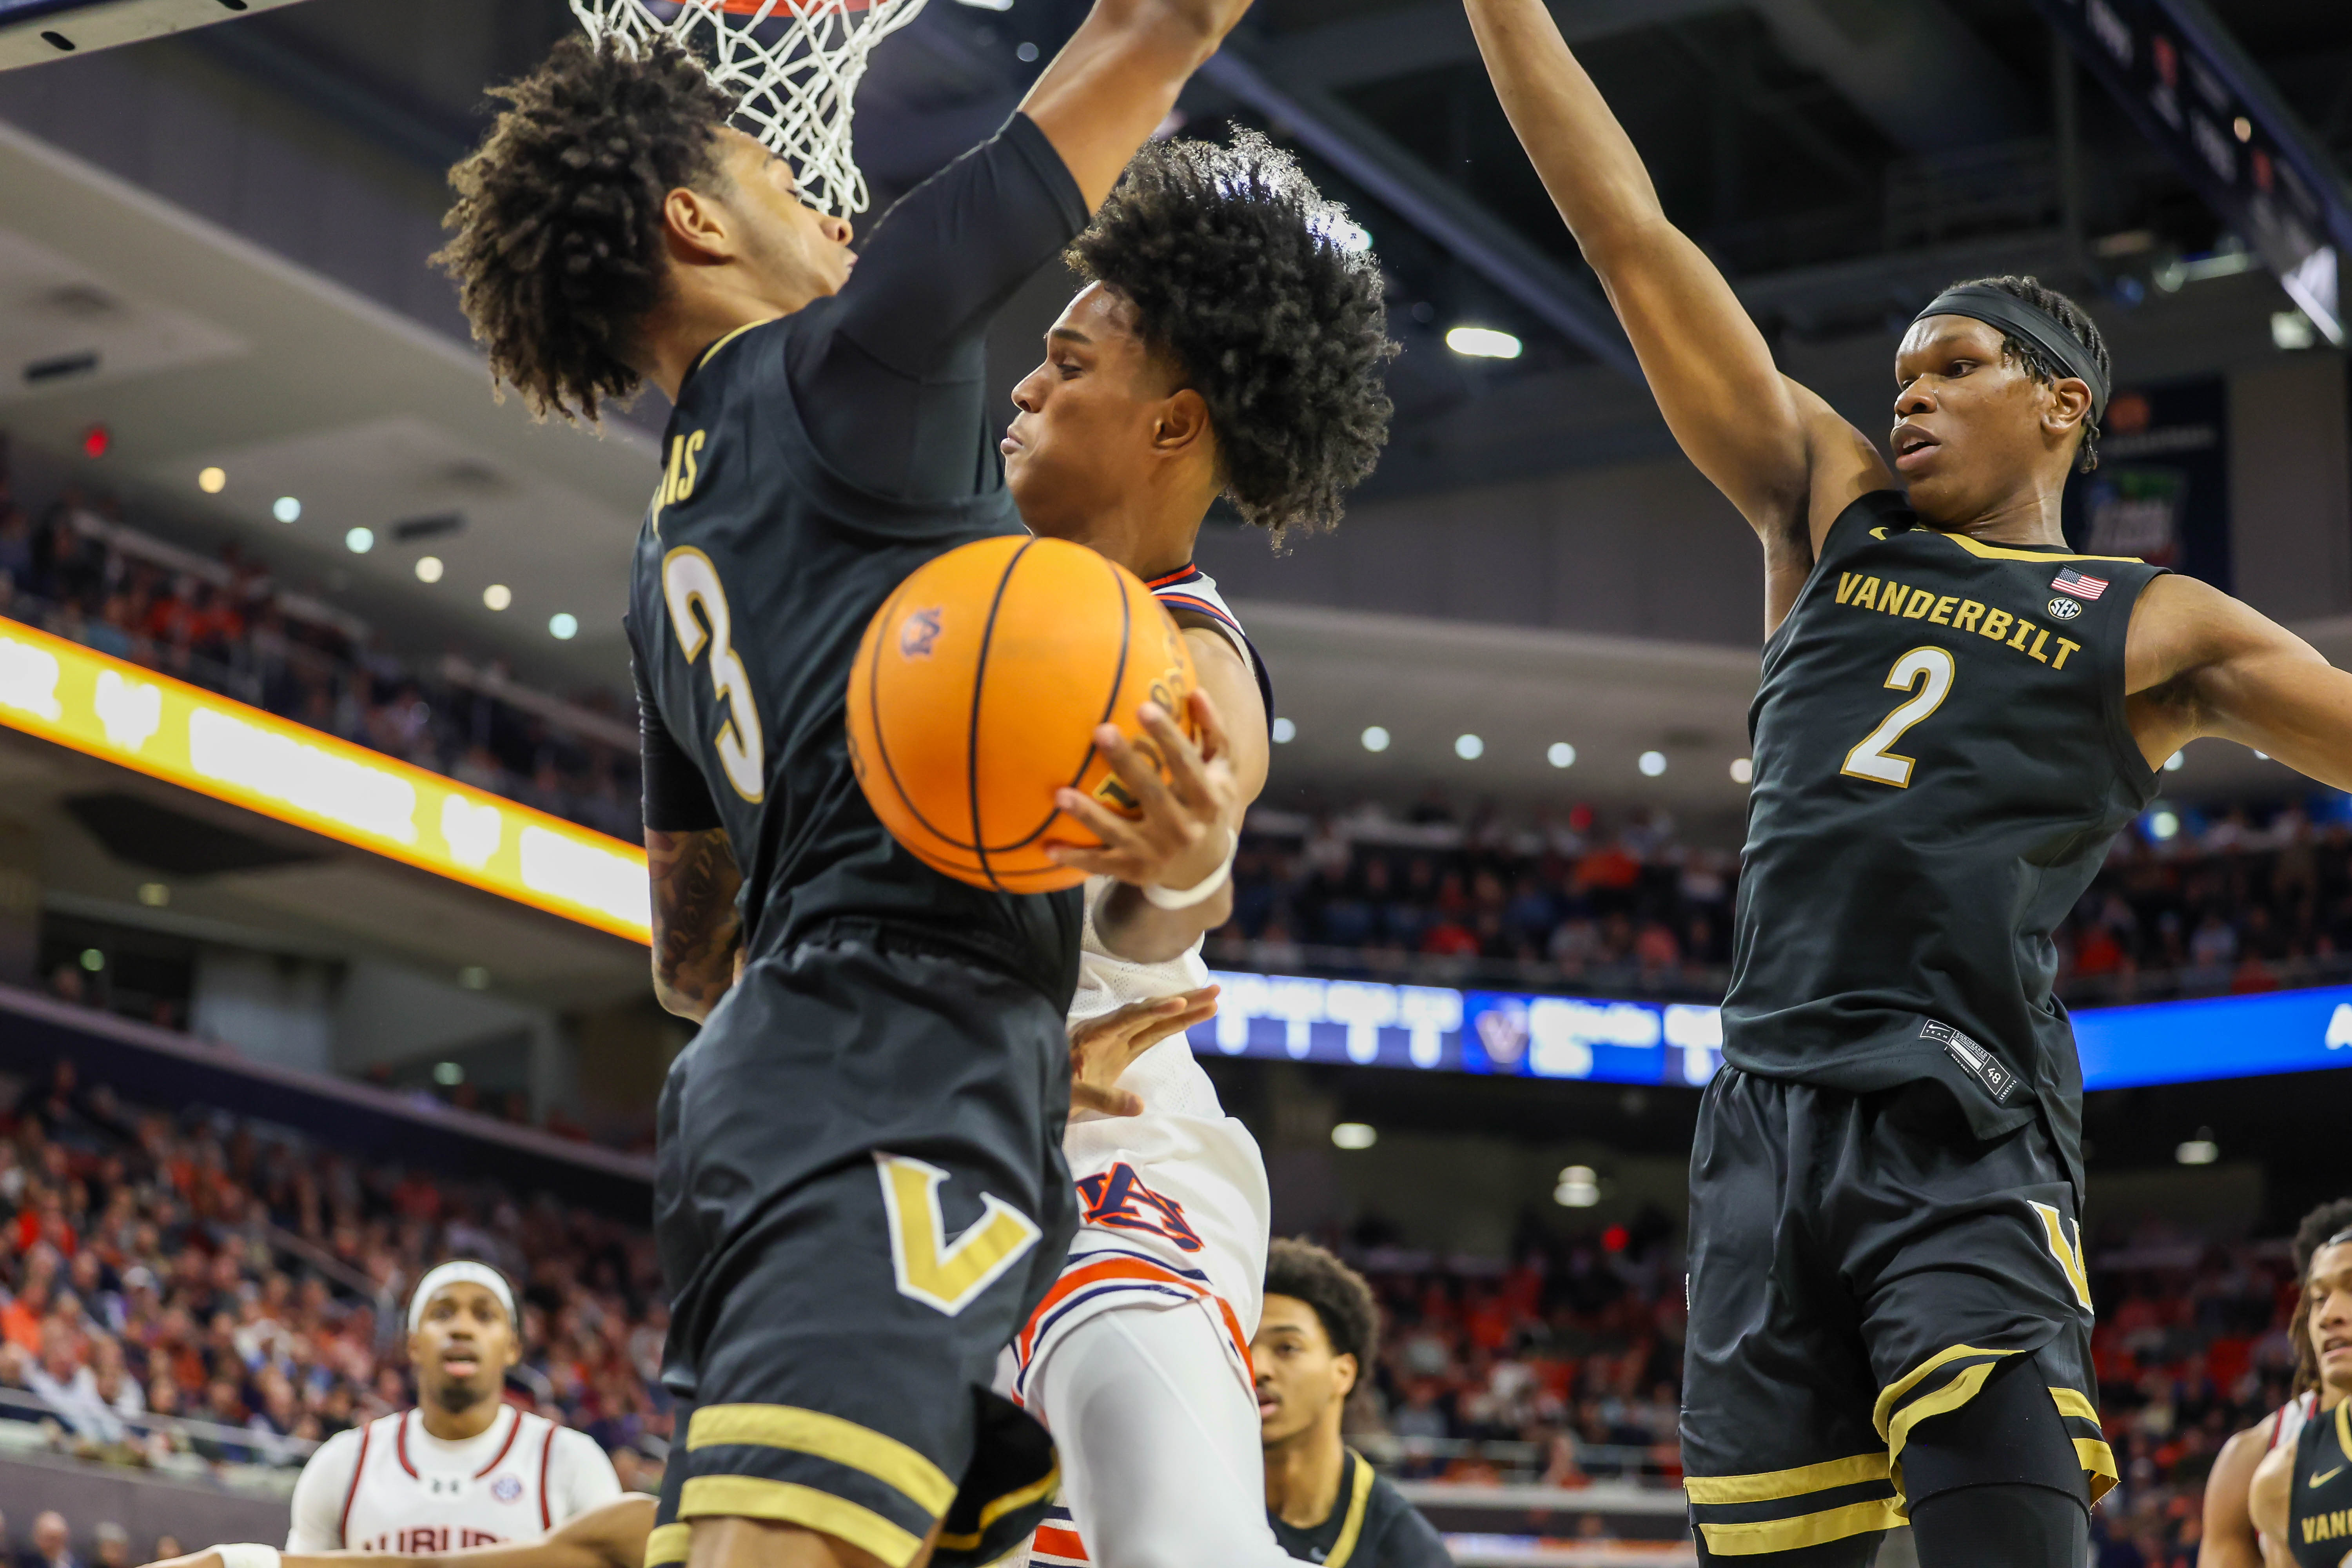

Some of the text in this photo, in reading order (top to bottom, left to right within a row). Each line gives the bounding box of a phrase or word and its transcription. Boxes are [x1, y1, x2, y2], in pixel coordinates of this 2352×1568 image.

[2051, 599, 2078, 618] SEC
[1835, 572, 2080, 670] VANDERBILT
[662, 545, 764, 804] 3
[1840, 645, 1955, 788] 2
[1926, 1029, 1948, 1039] TEAM
[1957, 1033, 1987, 1057] ENGINEERED
[1987, 1068, 2001, 1084] 48
[1999, 1085, 2013, 1100] LENGTH
[871, 1150, 1043, 1318] V
